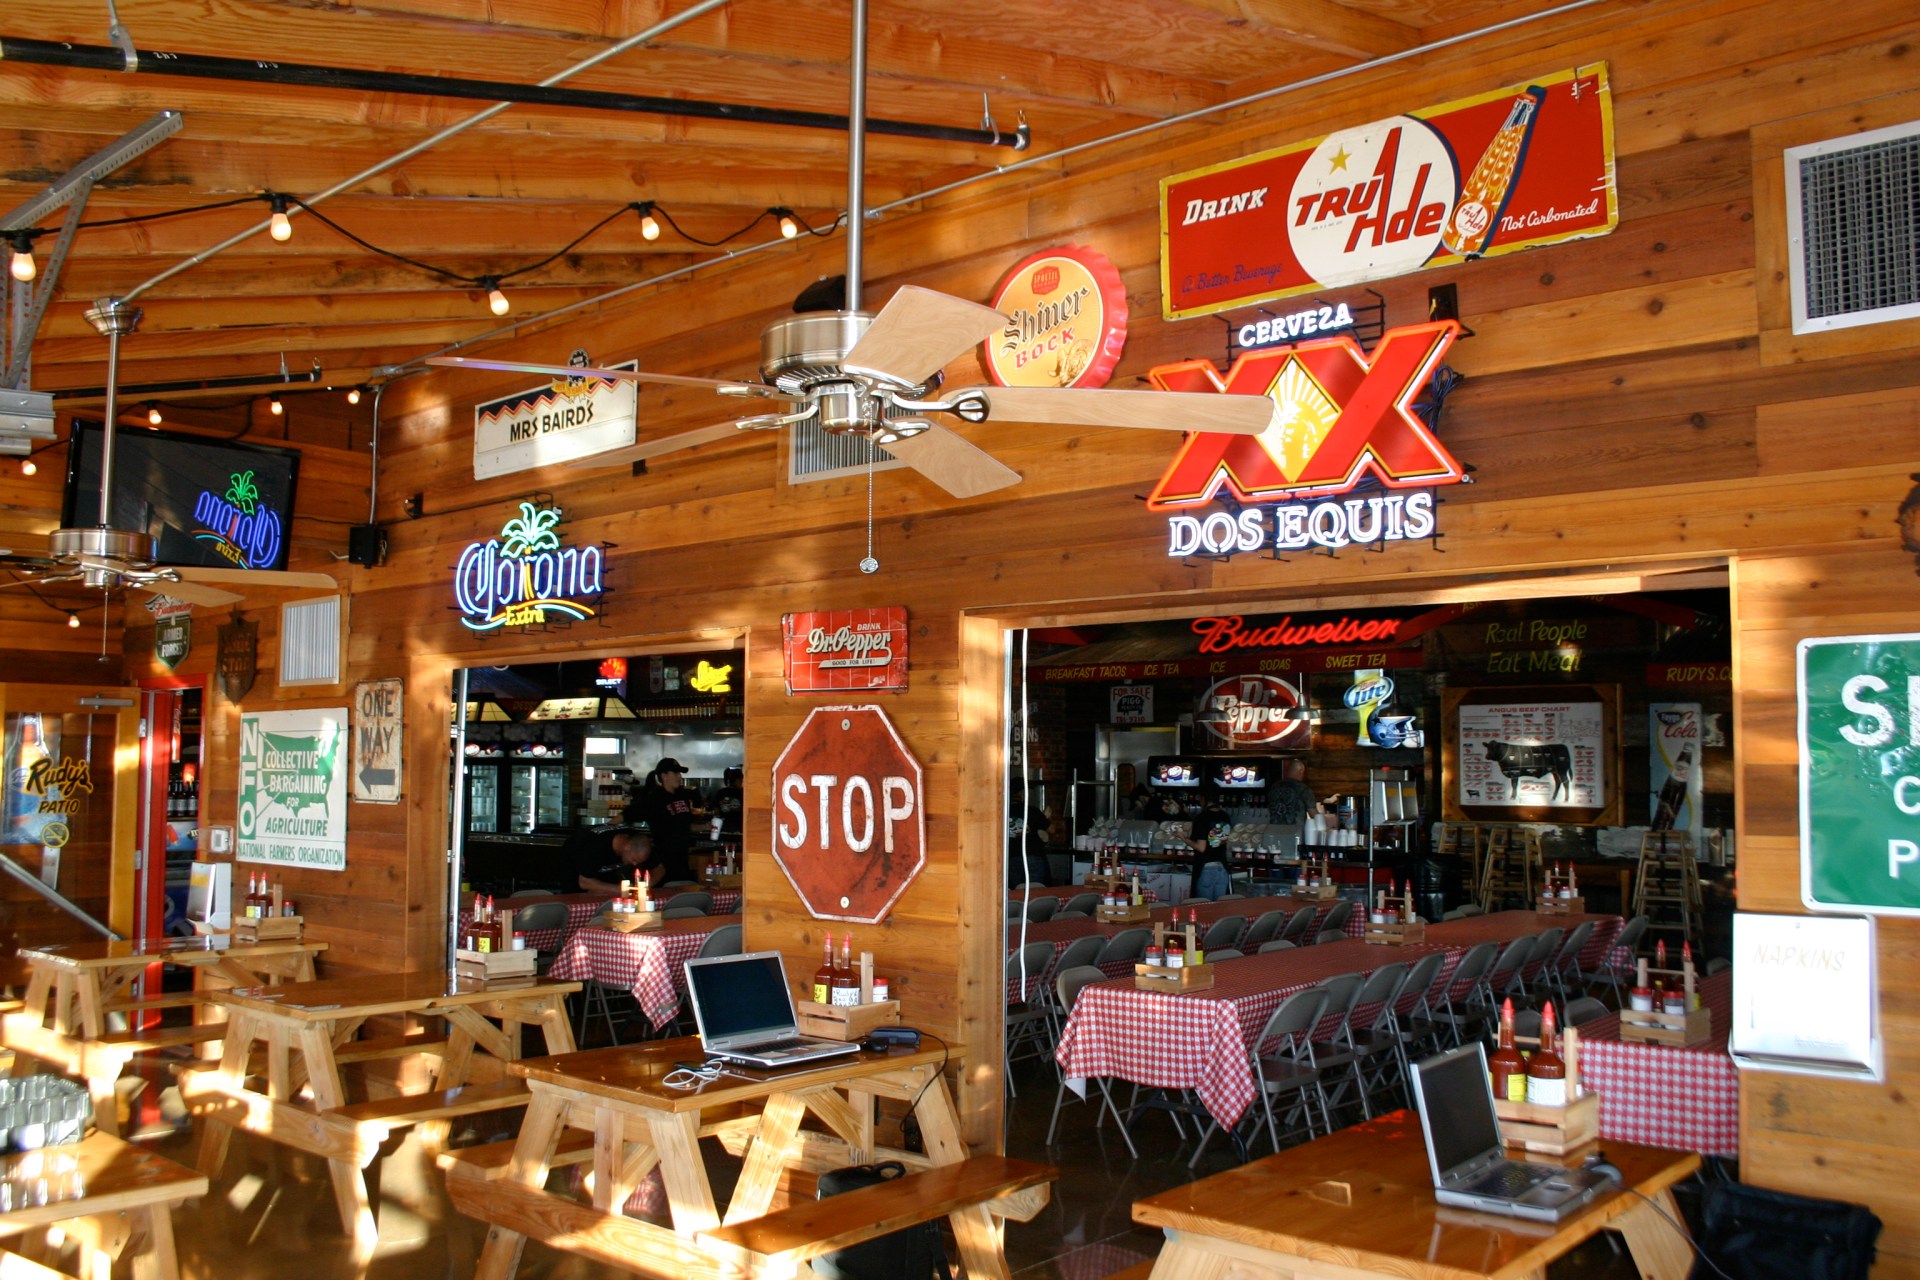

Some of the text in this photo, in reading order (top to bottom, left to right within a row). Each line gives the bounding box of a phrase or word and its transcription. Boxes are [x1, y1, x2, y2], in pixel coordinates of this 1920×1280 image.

[1294, 174, 1383, 228] TRU
[1344, 126, 1446, 254] Ade
[1182, 186, 1268, 227] DRINK
[1500, 214, 1526, 232] Not
[1526, 197, 1598, 228] Carbonated
[1233, 260, 1285, 289] Beverage
[1000, 286, 1090, 357] Shiner
[1238, 303, 1353, 347] CERVEZA
[1015, 327, 1075, 369] BOCK
[510, 399, 594, 442] MRS BAIRD'S
[1168, 493, 1435, 557] DOS EQUIS
[455, 539, 602, 623] Corona
[504, 604, 546, 625] Extra
[857, 622, 881, 631] DRINK
[1191, 615, 1400, 653] Budweiser
[1485, 619, 1588, 646] Real People
[161, 643, 183, 658] FORCES
[1325, 653, 1387, 669] SWEET TEA
[1487, 648, 1584, 674] Eat Meat
[1045, 665, 1126, 680] BREAKFAST TACOS
[1143, 663, 1180, 676] ICE TEA
[1209, 661, 1227, 673] ICE
[1259, 658, 1292, 671] SODAS
[362, 689, 394, 718] ONE
[1240, 681, 1278, 705] Dr
[1352, 685, 1386, 707] Lite
[1214, 694, 1296, 734] Pepper
[1664, 714, 1697, 738] Cola
[360, 726, 395, 754] WAY
[1014, 726, 1039, 743] BNS
[265, 750, 319, 769] COLLECTIVE
[26, 756, 94, 796] Rudy's
[269, 774, 327, 795] BARGAINING
[38, 799, 81, 814] PATIO
[286, 796, 299, 807] FOR
[779, 773, 915, 853] STOP
[264, 816, 329, 837] AGRICULTURE
[238, 842, 343, 866] NATIONAL FARMERS ORGANIZATION
[1753, 943, 1846, 971] NAPKINS
